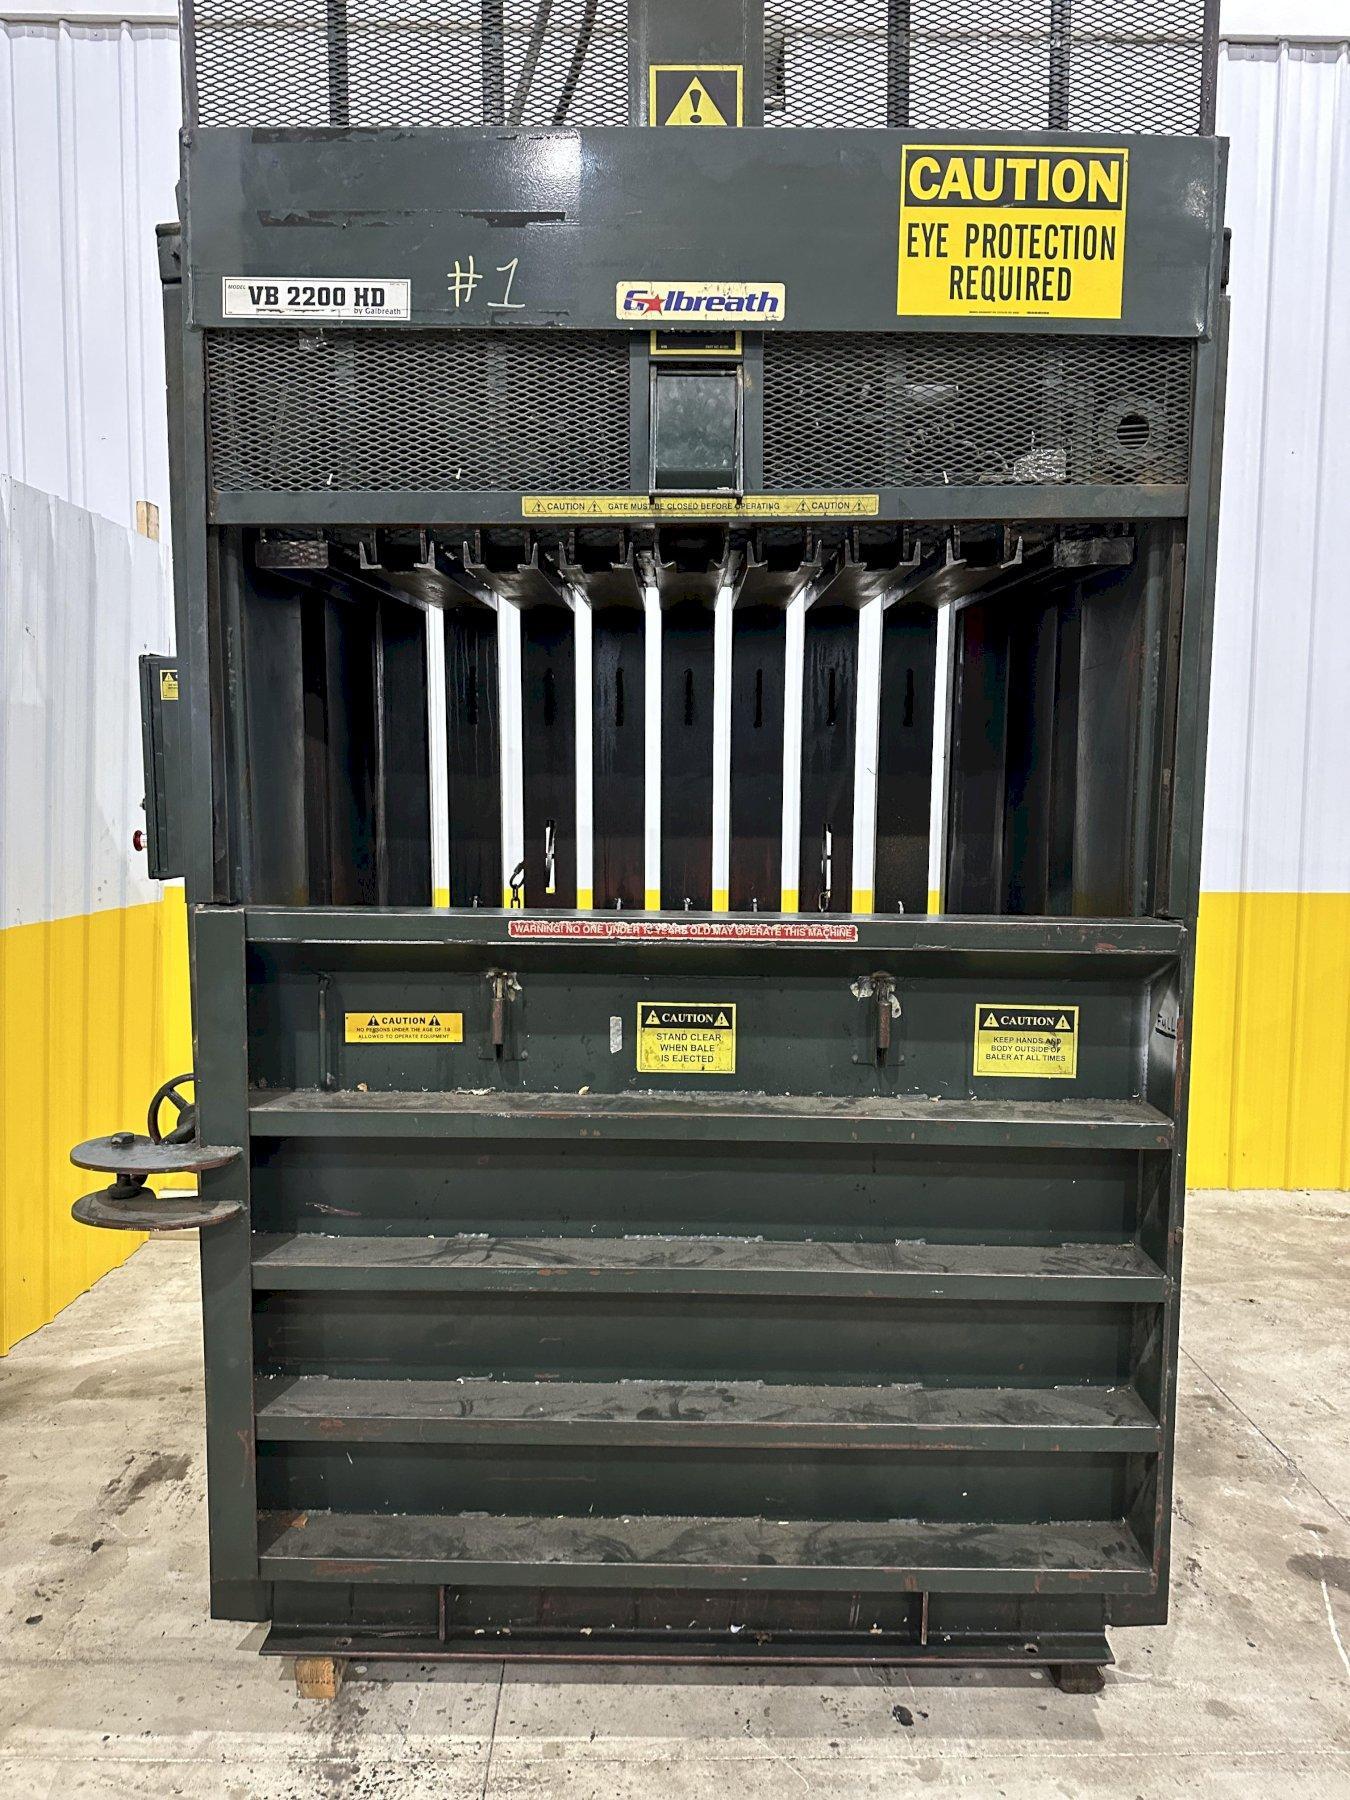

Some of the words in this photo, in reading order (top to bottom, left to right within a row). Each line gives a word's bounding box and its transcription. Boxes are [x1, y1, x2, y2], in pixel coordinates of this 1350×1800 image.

[909, 156, 1120, 203] CAUTION
[907, 222, 949, 258] EYE
[965, 223, 1116, 261] PROTECTION
[949, 265, 1072, 303] REQUIRED
[248, 286, 279, 306] VB
[287, 286, 346, 307] 2200
[353, 287, 385, 307] HD
[353, 307, 363, 315] by
[365, 307, 401, 315] Galbreath
[547, 502, 585, 511] CAUTION
[734, 502, 780, 510] OPERATING
[811, 501, 850, 510] CAUTION
[566, 925, 580, 934] NO
[583, 925, 604, 934] ONE
[606, 925, 640, 934] UNDER
[690, 926, 711, 935] OLD
[736, 927, 781, 936] OPERATE
[784, 927, 806, 937] THIS
[808, 928, 852, 937] MACHINE
[382, 1017, 426, 1025] CAUTION
[661, 1013, 714, 1024] CAUTION
[1000, 1015, 1055, 1026] CAUTION
[656, 1033, 688, 1041] STAND
[690, 1033, 722, 1042] CLEAR
[660, 1044, 688, 1052] WHEN
[690, 1044, 715, 1052] BALE
[1015, 1045, 1048, 1053] OUTSIDE
[672, 1055, 714, 1063] EJECTED
[985, 1053, 1012, 1061] BALER
